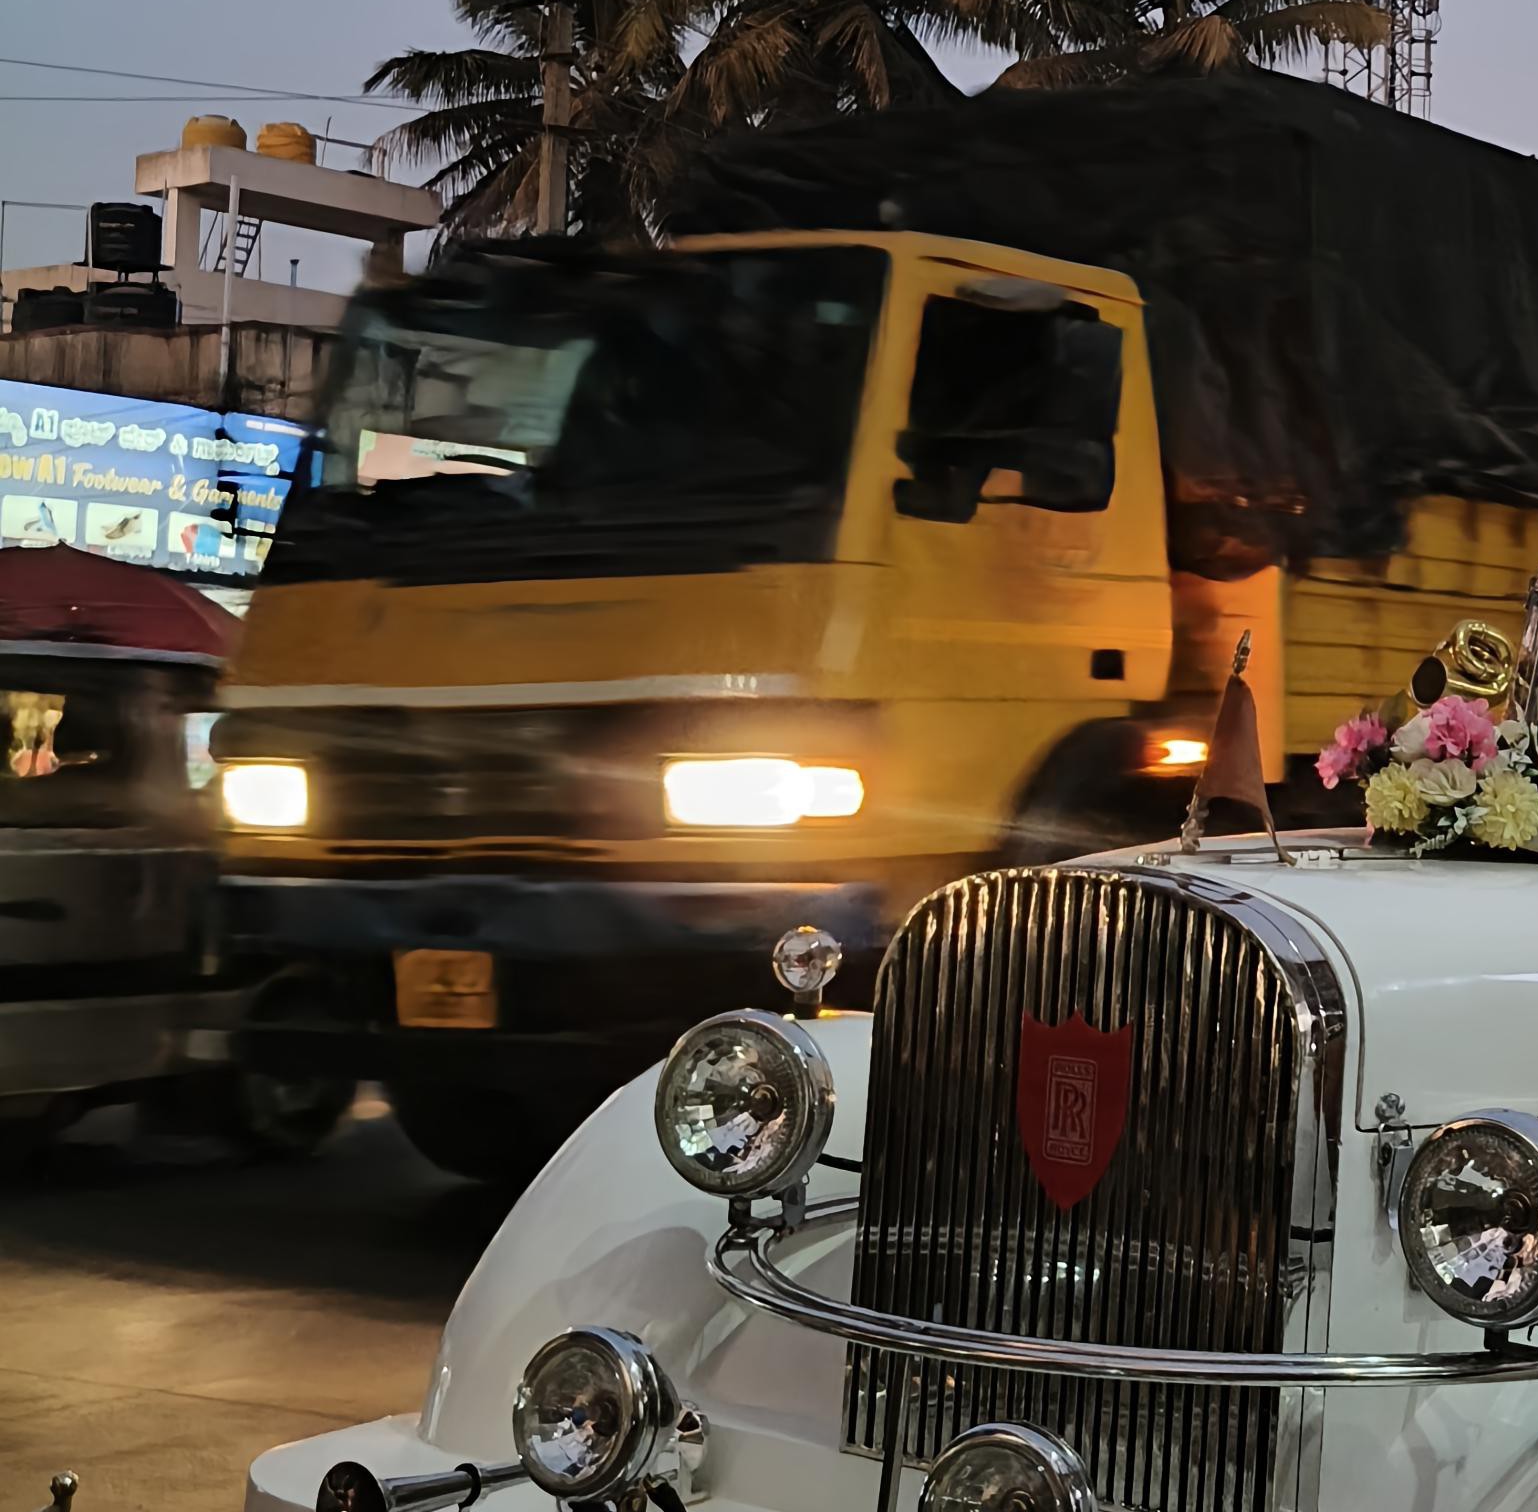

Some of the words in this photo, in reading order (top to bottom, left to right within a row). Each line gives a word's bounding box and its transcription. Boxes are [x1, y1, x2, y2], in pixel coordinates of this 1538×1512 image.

[32, 409, 57, 437] A1
[37, 454, 66, 485] A1
[72, 462, 163, 496] Footwear
[168, 474, 187, 502] &
